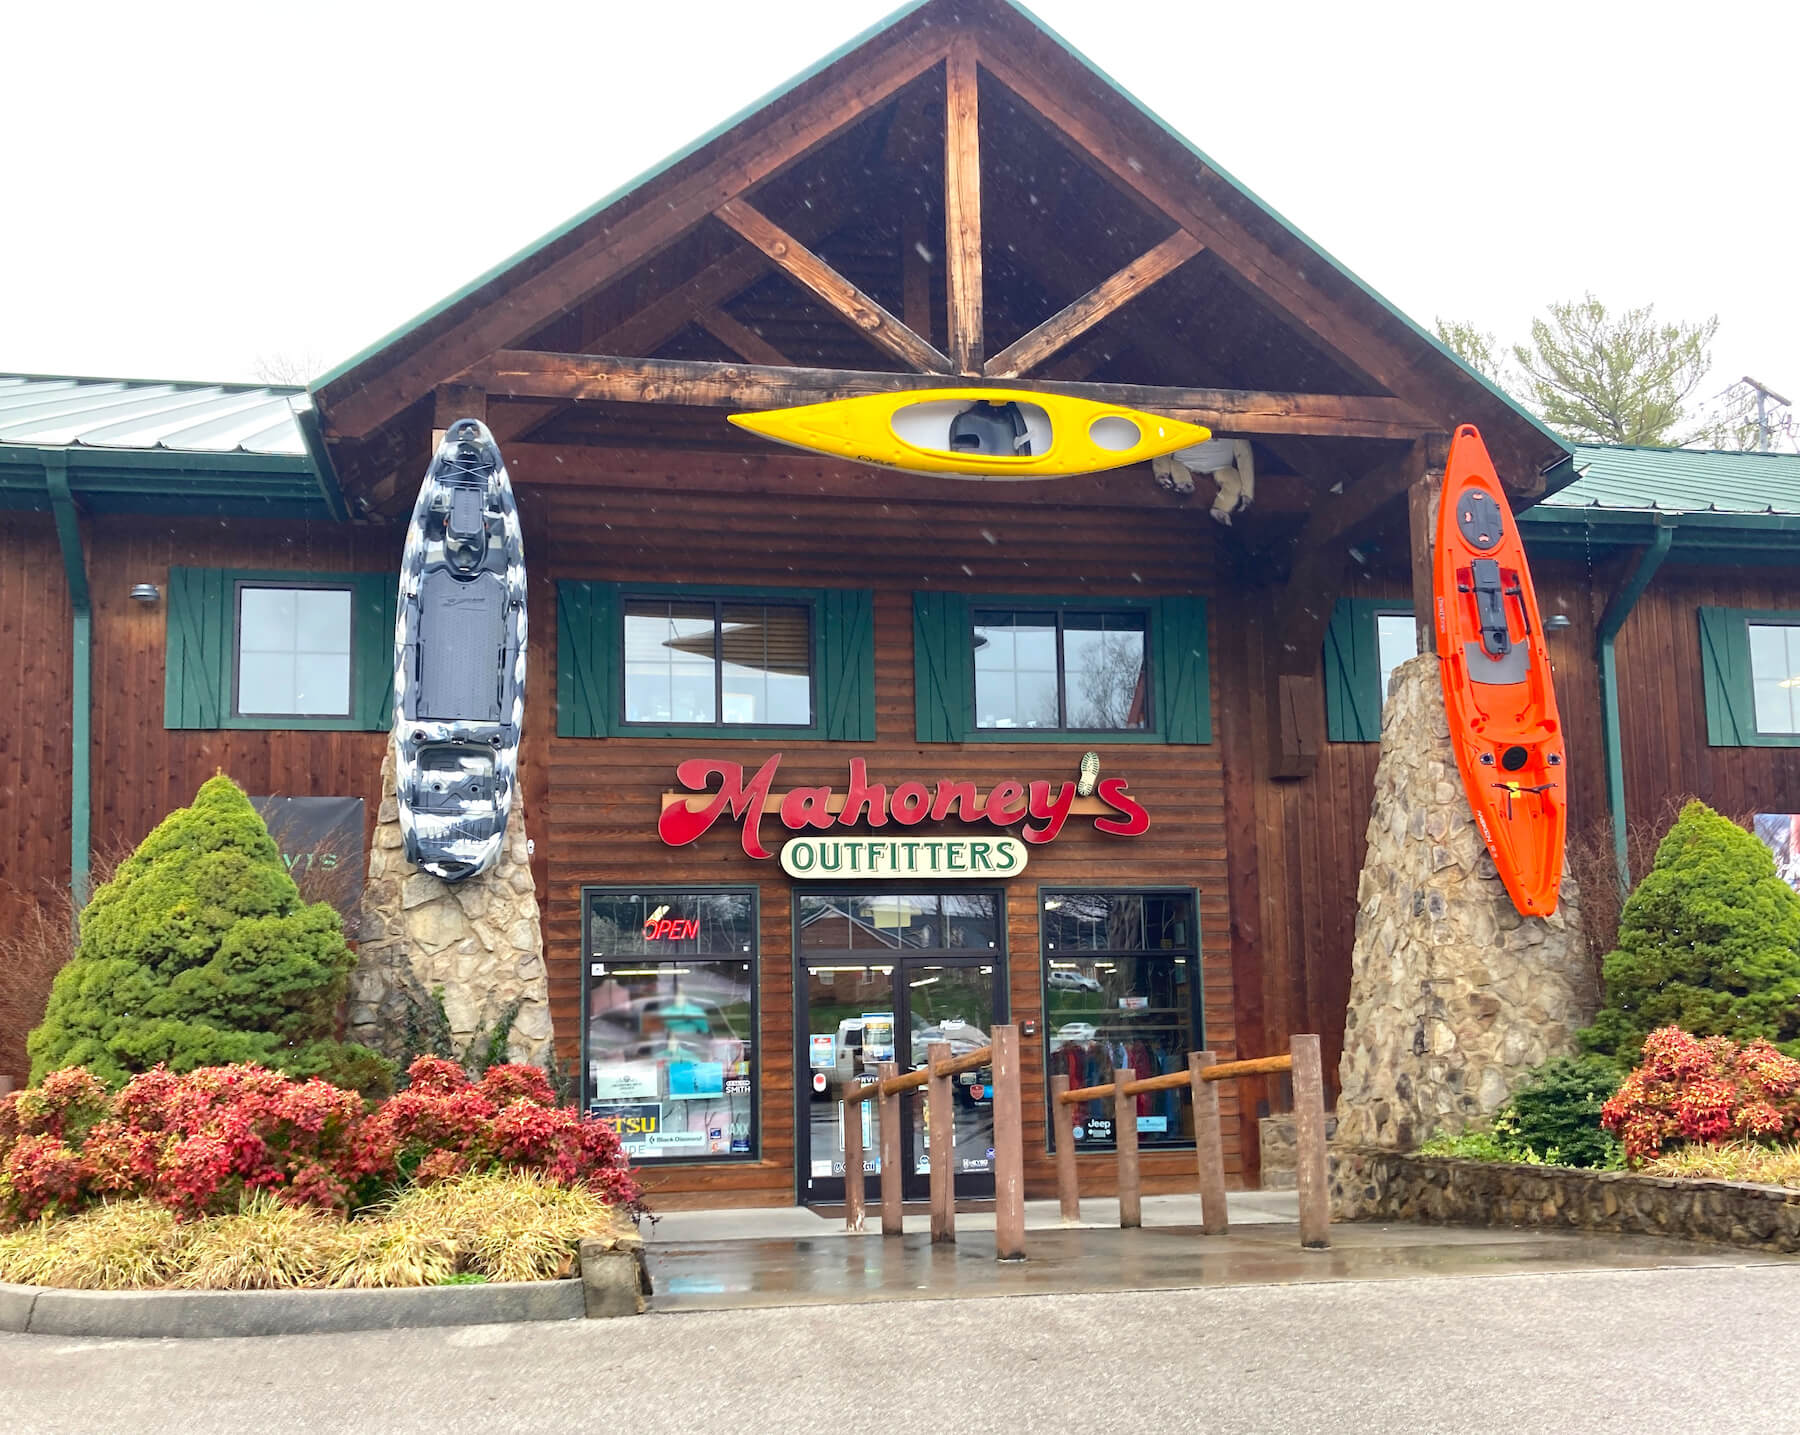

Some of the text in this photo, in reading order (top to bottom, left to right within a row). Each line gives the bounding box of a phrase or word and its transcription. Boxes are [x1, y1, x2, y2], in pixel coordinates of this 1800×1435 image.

[657, 751, 1151, 860] Mahoney's
[281, 853, 338, 871] VIS
[790, 841, 1016, 872] OUTFITTERS
[641, 919, 700, 941] OPEN
[725, 1086, 751, 1094] SMITH
[612, 1117, 656, 1134] TSU
[1088, 1118, 1111, 1129] Jeep
